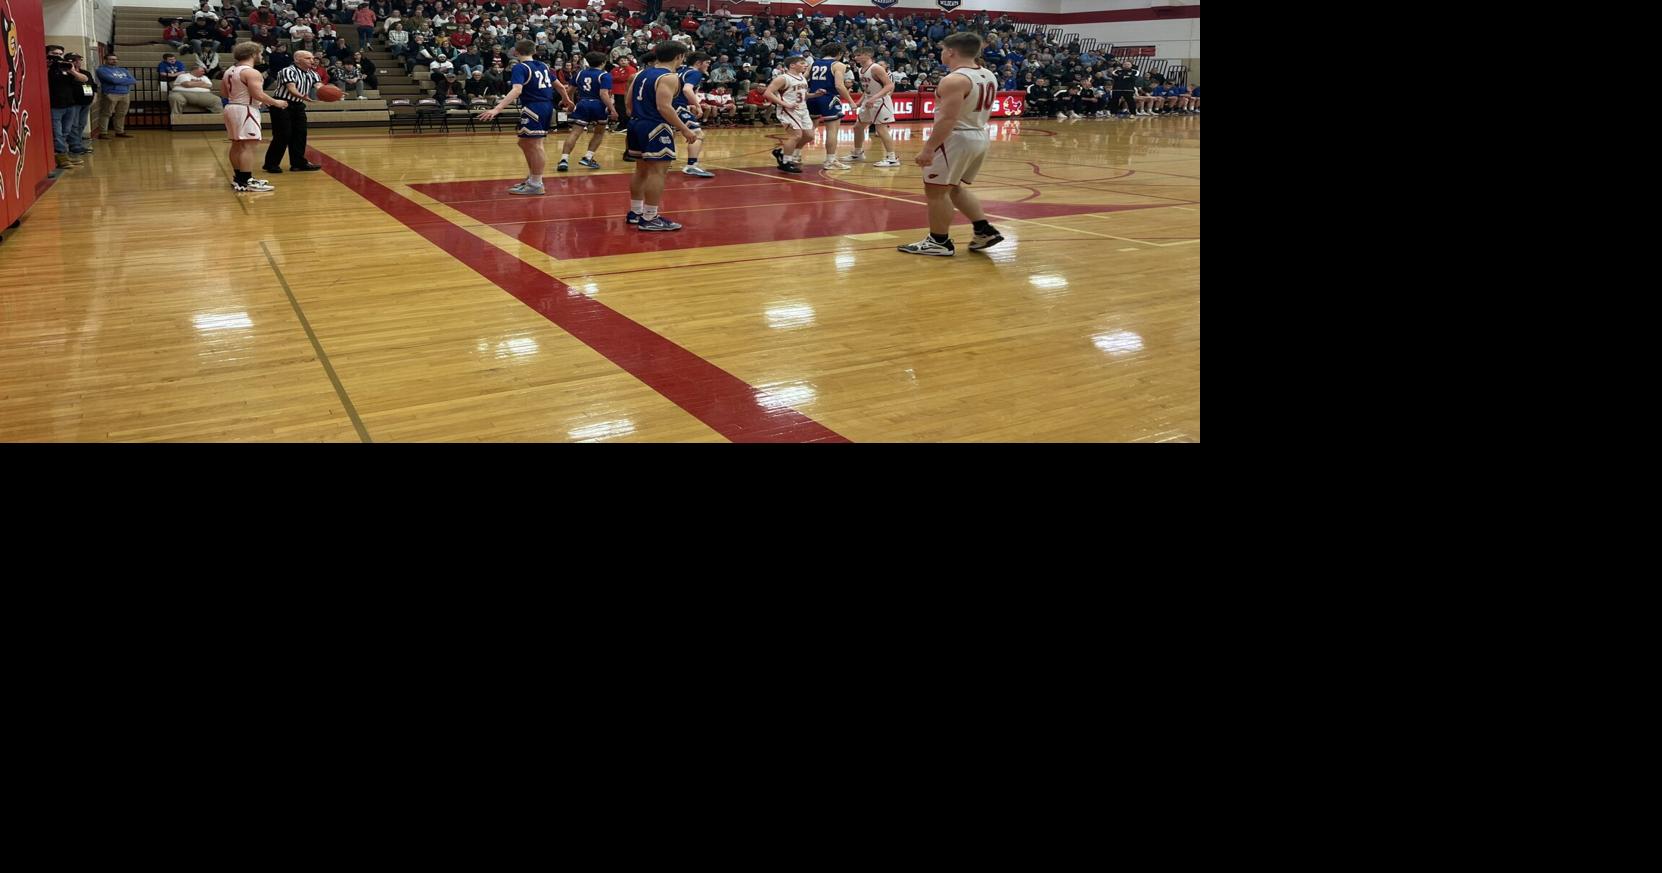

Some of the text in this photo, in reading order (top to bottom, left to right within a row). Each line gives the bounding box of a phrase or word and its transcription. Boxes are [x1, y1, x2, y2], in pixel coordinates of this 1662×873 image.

[534, 69, 552, 89] 24
[812, 66, 828, 81] 22
[583, 77, 592, 92] 3
[636, 78, 647, 101] 1
[972, 81, 996, 112] 10
